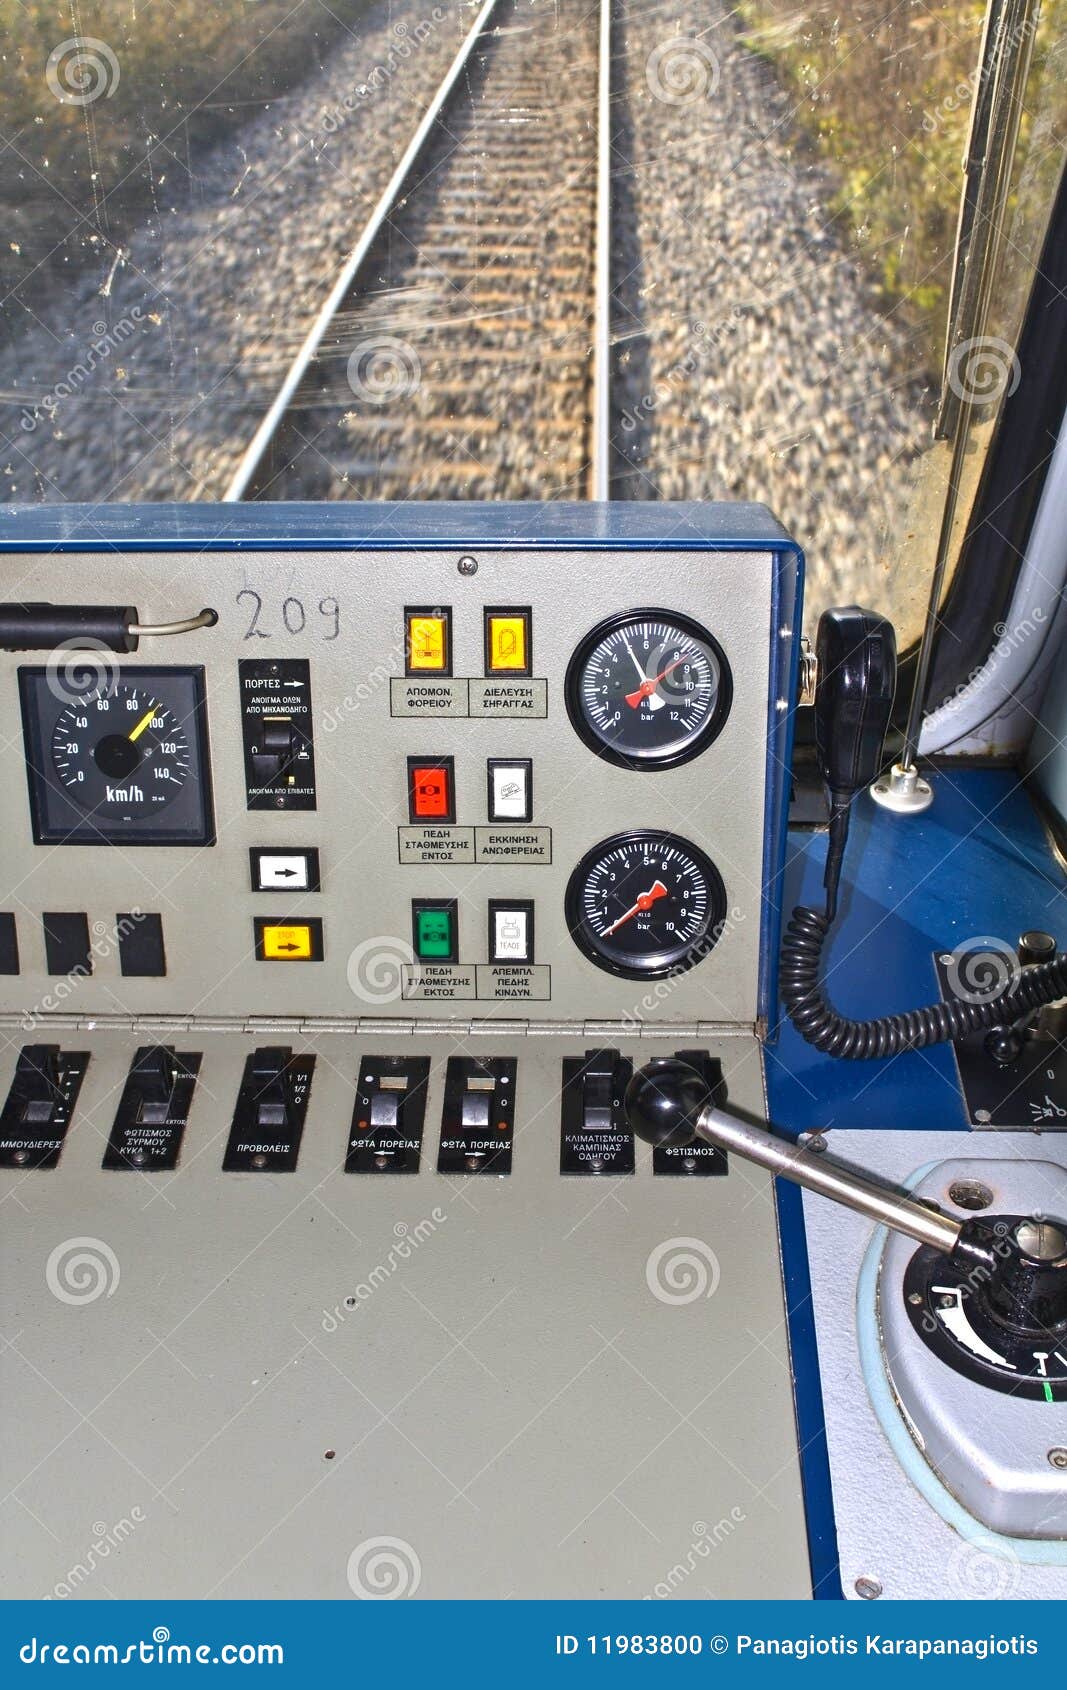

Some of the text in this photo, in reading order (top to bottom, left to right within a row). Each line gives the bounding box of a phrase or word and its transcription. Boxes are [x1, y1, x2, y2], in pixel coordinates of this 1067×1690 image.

[236, 590, 339, 640] 209
[644, 641, 650, 650] 6
[660, 644, 666, 653] 7
[612, 654, 619, 664] 4
[674, 652, 680, 661] 8
[605, 669, 611, 678] 3
[684, 665, 690, 674] 9
[245, 680, 281, 689] ΠΟΡΤΕΣ
[685, 682, 695, 691] 10
[484, 689, 533, 697] ΔΙΕΛΕΥΣΗ
[602, 686, 608, 695] 2
[97, 700, 109, 711] 60
[127, 700, 138, 711] 80
[408, 700, 452, 708] ΦΟΡΕΙΟΥ
[483, 700, 534, 708] ΣΗΡΑΓΓΑΣ
[605, 702, 609, 710] 1
[685, 699, 691, 708] 11
[615, 711, 621, 720] 0
[670, 712, 679, 721] 12
[76, 717, 88, 728] 40
[149, 717, 164, 729] 100
[66, 743, 79, 754] 20
[161, 743, 177, 754] 120
[78, 771, 84, 782] 0
[154, 768, 170, 779] 140
[106, 786, 144, 802] km/h
[489, 836, 538, 844] ΕΚΚΙΝΗΣΗ
[482, 847, 545, 855] ΑΝΩΦΕΡΕΙΑΣ
[624, 860, 630, 869] 4
[644, 857, 650, 866] 5
[662, 862, 668, 871] 6
[610, 873, 616, 882] 3
[677, 875, 683, 883] 7
[602, 890, 608, 898] 2
[684, 891, 690, 899] 8
[604, 907, 608, 915] 1
[681, 909, 686, 917] 9
[666, 922, 675, 931] 10
[426, 968, 452, 976] ΠΕΔΗ
[566, 1135, 630, 1143] ΚΛΙΜΑΤΙΣΜΟΣ
[237, 1144, 291, 1153] ΠΡΟΒΟΛΕΙΣ
[351, 1140, 420, 1149] ΦΩΤΑ ΠΟΡΕΙΑΣ
[442, 1141, 467, 1149] ΦΩΤΑ
[574, 1144, 622, 1152] ΚΑΜΠΙΝΑΣ
[666, 1148, 715, 1156] ΦΩΤΙΣΜΟΣ
[579, 1153, 616, 1161] ΟΔΗΓΟΥ
